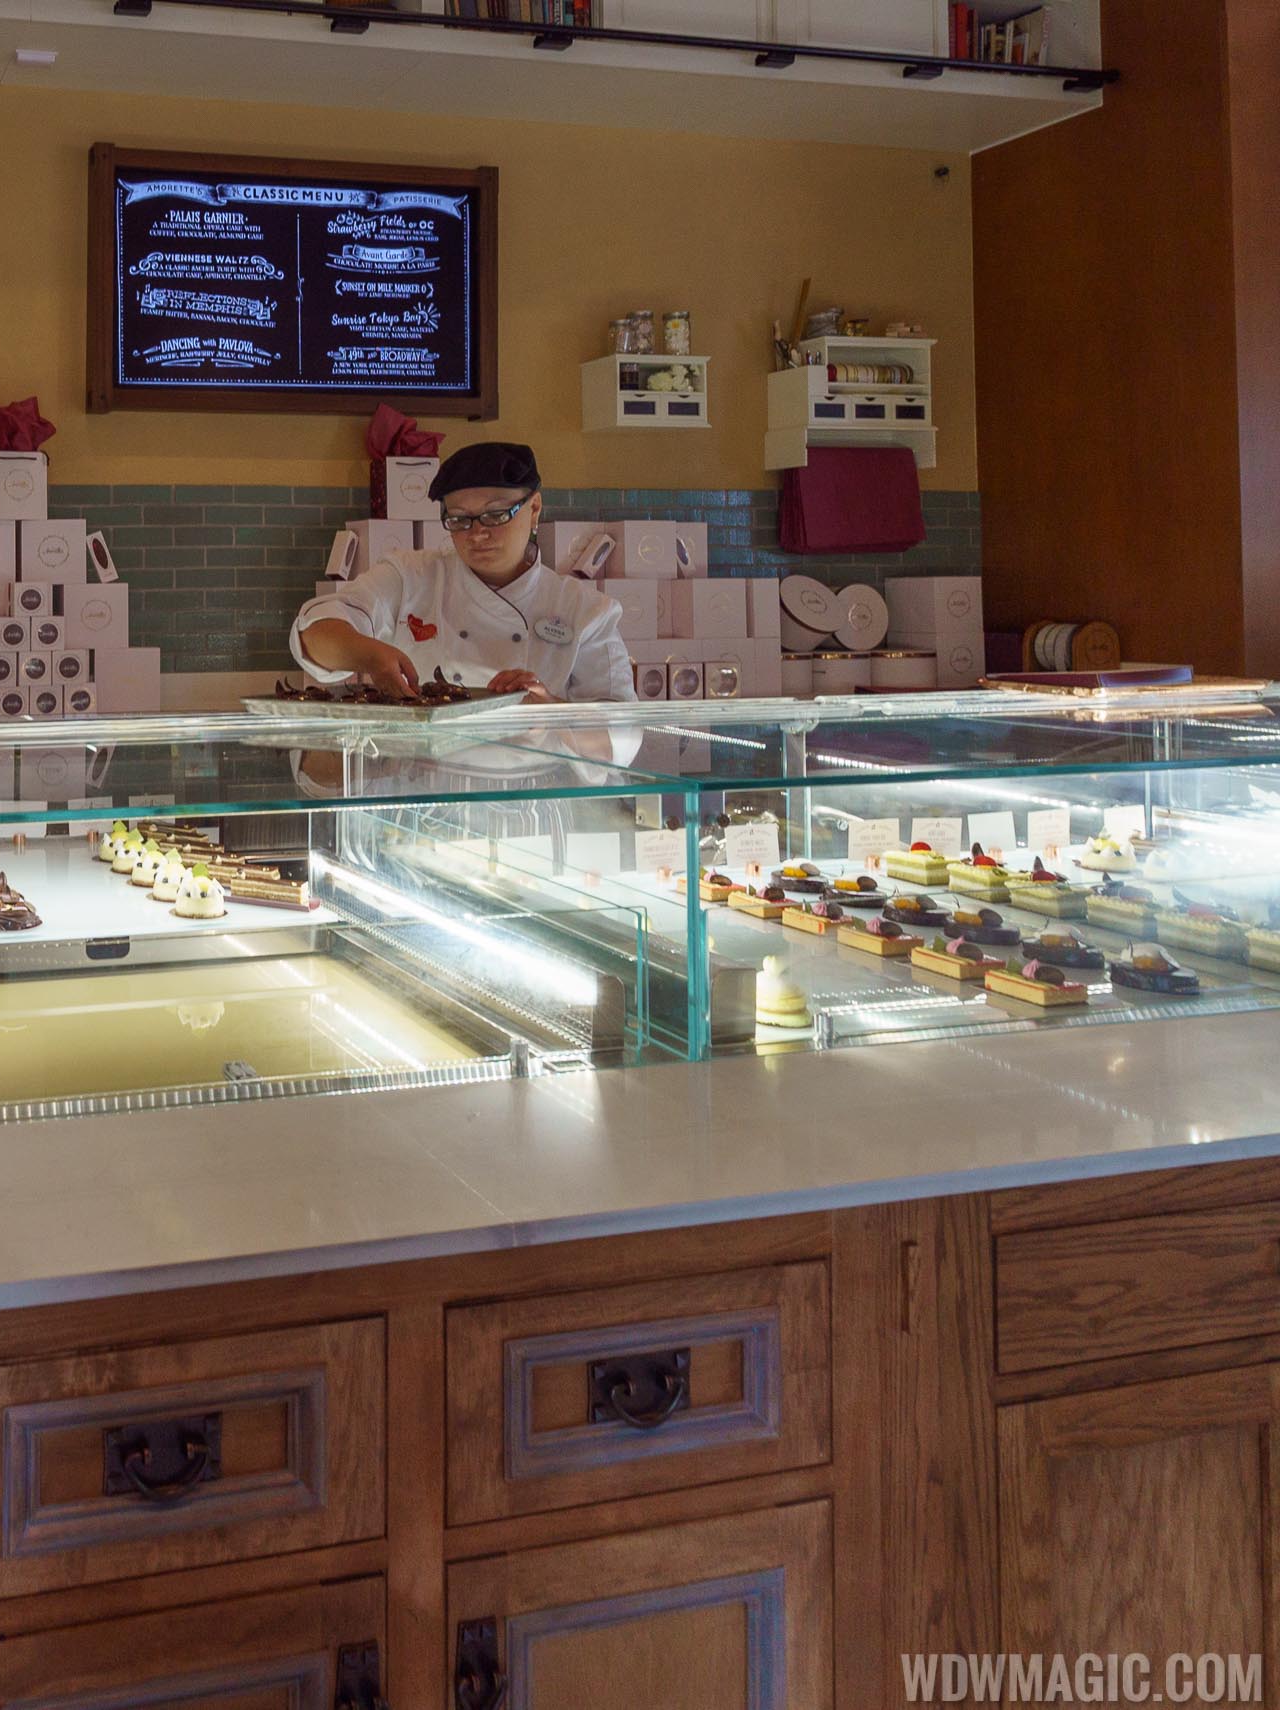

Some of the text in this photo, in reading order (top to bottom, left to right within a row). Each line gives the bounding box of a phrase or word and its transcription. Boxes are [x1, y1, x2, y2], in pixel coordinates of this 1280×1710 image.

[147, 184, 203, 196] AMORETTE'S
[243, 187, 344, 201] CLASSIC MENU
[170, 210, 244, 225] PALAIS GARNIER
[327, 220, 377, 234] Strawberry
[380, 214, 406, 228] Fields
[160, 222, 201, 230] TRADITIONAL
[164, 253, 249, 265] VIENNESE WALTZ
[361, 250, 384, 260] Avant
[341, 281, 366, 291] SUNSET
[366, 282, 376, 292] ON
[378, 282, 393, 292] MILE
[394, 283, 420, 293] MARKER
[167, 289, 247, 306] REFLECTIONS
[170, 299, 242, 315] IN MEMPHIS
[331, 311, 421, 327] Sunrise Tokyo Bay
[161, 337, 253, 354] DANCING with PAVLOVA
[348, 350, 364, 361] 49th
[380, 350, 420, 361] BROADWAY
